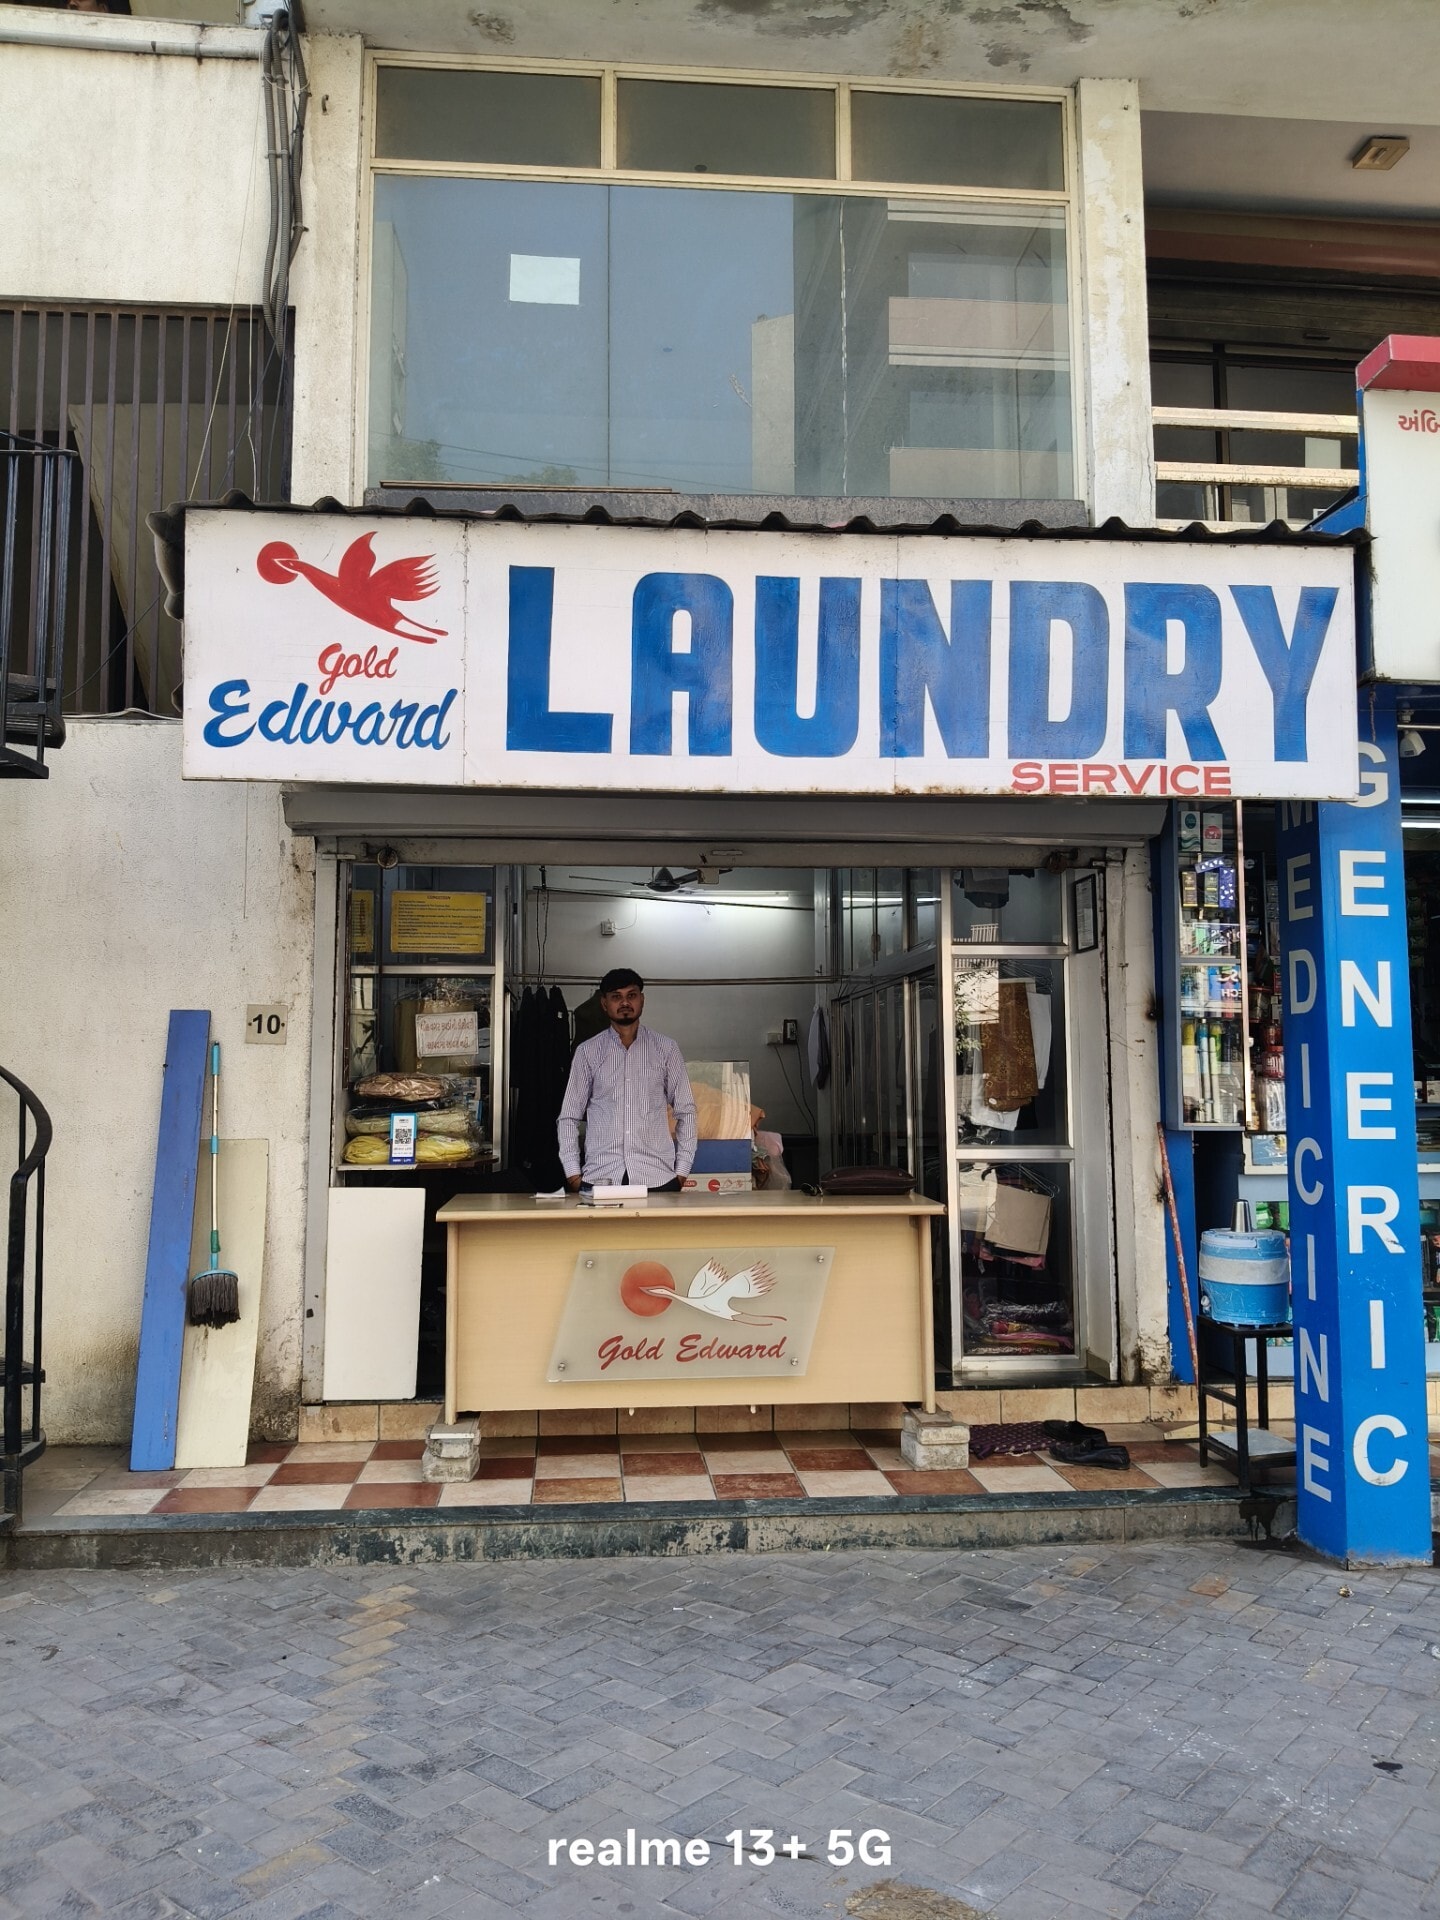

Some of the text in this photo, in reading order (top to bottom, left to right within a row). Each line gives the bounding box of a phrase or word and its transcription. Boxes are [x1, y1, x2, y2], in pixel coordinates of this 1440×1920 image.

[506, 565, 1340, 763] LAUNDRY
[202, 678, 458, 750] Edward
[1011, 761, 1232, 796] SERVICE
[252, 1014, 281, 1035] 10
[598, 1334, 787, 1370] Gold Edward
